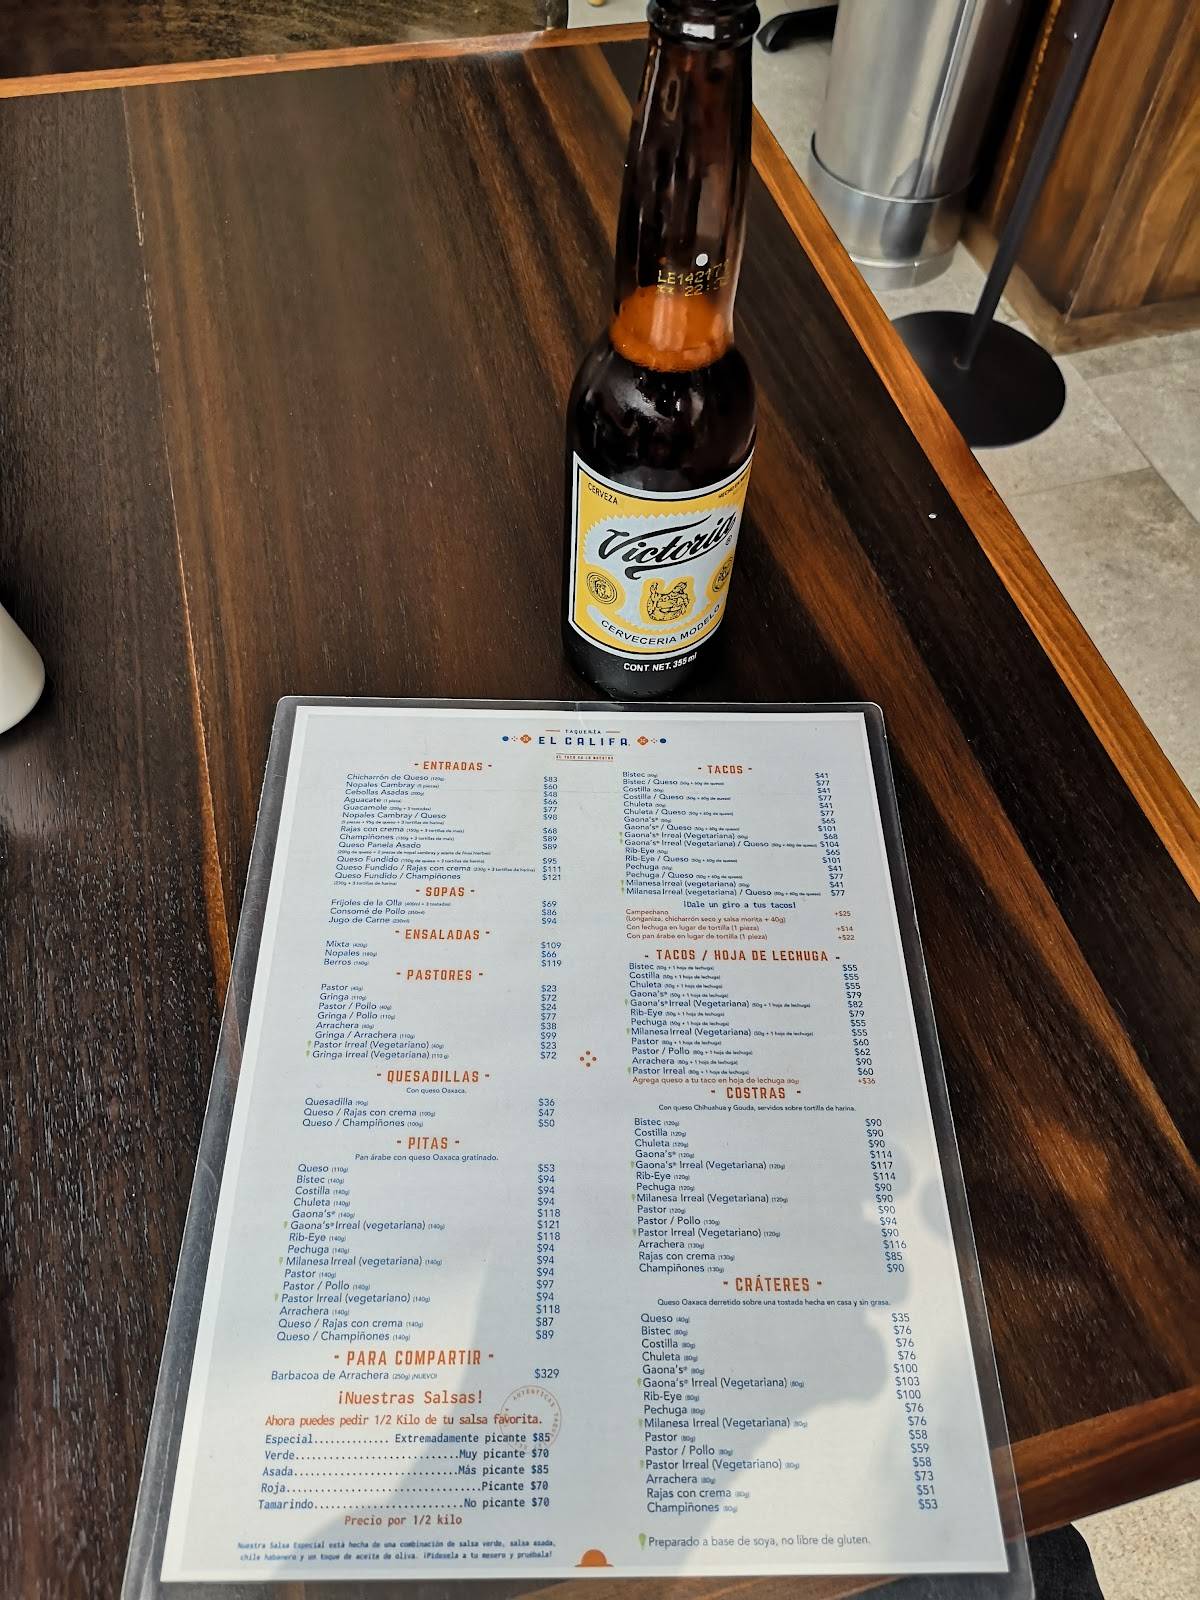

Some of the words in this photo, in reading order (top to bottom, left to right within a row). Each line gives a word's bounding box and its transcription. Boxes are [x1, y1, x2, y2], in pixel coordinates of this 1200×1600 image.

[587, 482, 619, 505] CERVEZA
[598, 512, 737, 581] Victoria
[601, 619, 677, 645] CERVECERIA
[679, 604, 720, 641] MODELO
[652, 662, 672, 671] NET.
[673, 657, 687, 669] 355
[688, 653, 697, 663] ml
[539, 737, 557, 745] EL
[423, 761, 483, 771] ENTRADAS
[707, 765, 743, 774] TACOS
[346, 773, 389, 781] Chicharrón
[426, 887, 465, 897] SOPAS
[331, 899, 361, 907] Frijoles
[722, 901, 741, 909] giro
[328, 916, 349, 925] Jugo
[349, 916, 363, 924] de
[542, 917, 557, 925] $94
[405, 929, 480, 940] ENSALADAS
[326, 940, 350, 948] Mixta
[540, 941, 562, 950] $109
[325, 949, 360, 958] Nopales
[656, 949, 696, 960] TACOS
[714, 950, 746, 961] HOJA
[752, 950, 766, 961] DE
[772, 950, 828, 961] LECHUGA
[407, 970, 472, 981] PASTORES
[319, 992, 349, 1002] Gringa
[541, 994, 557, 1002] $72
[315, 1021, 359, 1029] Arrachera
[541, 1022, 557, 1030] $38
[387, 1070, 479, 1083] QUESADILLAS
[726, 1087, 785, 1099] COSTRAS
[305, 1097, 353, 1107] Quesadilla
[538, 1098, 555, 1107] $36
[634, 1118, 662, 1126] Bistec
[865, 1118, 882, 1127] $90
[408, 1137, 448, 1150] PITAS
[297, 1164, 329, 1173] Queso
[538, 1164, 555, 1173] $53
[296, 1175, 325, 1184] Bistec
[537, 1174, 555, 1184] $94
[295, 1186, 330, 1195] Costilla
[537, 1186, 555, 1195] $94
[636, 1182, 676, 1193] Pechuga
[874, 1183, 892, 1192] $90
[289, 1232, 326, 1244] Rib-Eye
[537, 1232, 561, 1241] $118
[638, 1239, 685, 1249] Arrachera
[883, 1239, 907, 1249] $116
[638, 1251, 663, 1263] Rajas
[666, 1253, 684, 1261] con
[885, 1251, 903, 1261] $85
[735, 1274, 809, 1292] CRÁTERES
[279, 1306, 329, 1316] Arrachera
[536, 1305, 561, 1314] $118
[641, 1313, 673, 1323] Queso
[891, 1313, 910, 1323] $35
[642, 1326, 671, 1336] Bistec
[893, 1325, 912, 1335] $76
[347, 1350, 387, 1366] PARA
[395, 1350, 481, 1366] COMPARTIR
[271, 1370, 319, 1380] Barbacoa
[322, 1369, 336, 1380] de
[338, 1369, 389, 1380] Arrachera
[535, 1368, 560, 1379] $329
[339, 1390, 414, 1405] ¡Nuestras
[424, 1390, 482, 1404] Salsas!
[644, 1391, 682, 1404] Rib-Eye
[896, 1389, 921, 1400] $100
[644, 1404, 688, 1417] Pechuga
[905, 1403, 924, 1413] $76
[265, 1415, 295, 1426] Ahora
[300, 1415, 335, 1428] puedes
[340, 1415, 369, 1427] pedir
[375, 1415, 392, 1425] 1/2
[396, 1414, 420, 1425] Kilo
[424, 1414, 437, 1425] de
[443, 1416, 454, 1425] tu
[459, 1414, 488, 1425] salsa
[493, 1414, 542, 1425] favorita.
[395, 1433, 479, 1443] Extremadamente
[485, 1432, 526, 1446] picante
[532, 1432, 550, 1443] $85
[645, 1431, 678, 1442] Pastor
[909, 1430, 928, 1440] $58
[483, 1449, 526, 1461] picante
[532, 1448, 549, 1458] $70
[483, 1464, 525, 1476] picante
[531, 1464, 549, 1474] $85
[646, 1473, 698, 1484] Arrachera
[914, 1471, 934, 1482] $73
[531, 1481, 548, 1491] $70
[647, 1488, 674, 1500] Rajas
[677, 1490, 696, 1499] con
[699, 1490, 732, 1498] crema
[916, 1485, 935, 1496] $51
[483, 1497, 525, 1510] picante
[532, 1497, 550, 1507] $70
[647, 1502, 720, 1515] Champiñones
[918, 1499, 938, 1510] $53
[345, 1514, 382, 1526] Precio
[388, 1517, 407, 1527] por
[414, 1514, 431, 1525] 1/2
[437, 1514, 462, 1525] kilo
[649, 1536, 700, 1549] Preparado
[711, 1536, 734, 1547] base
[737, 1535, 751, 1546] de
[753, 1538, 779, 1549] soya,
[781, 1537, 794, 1546] no
[796, 1534, 820, 1545] libre
[821, 1534, 834, 1545] de
[837, 1534, 870, 1548] gluten.
